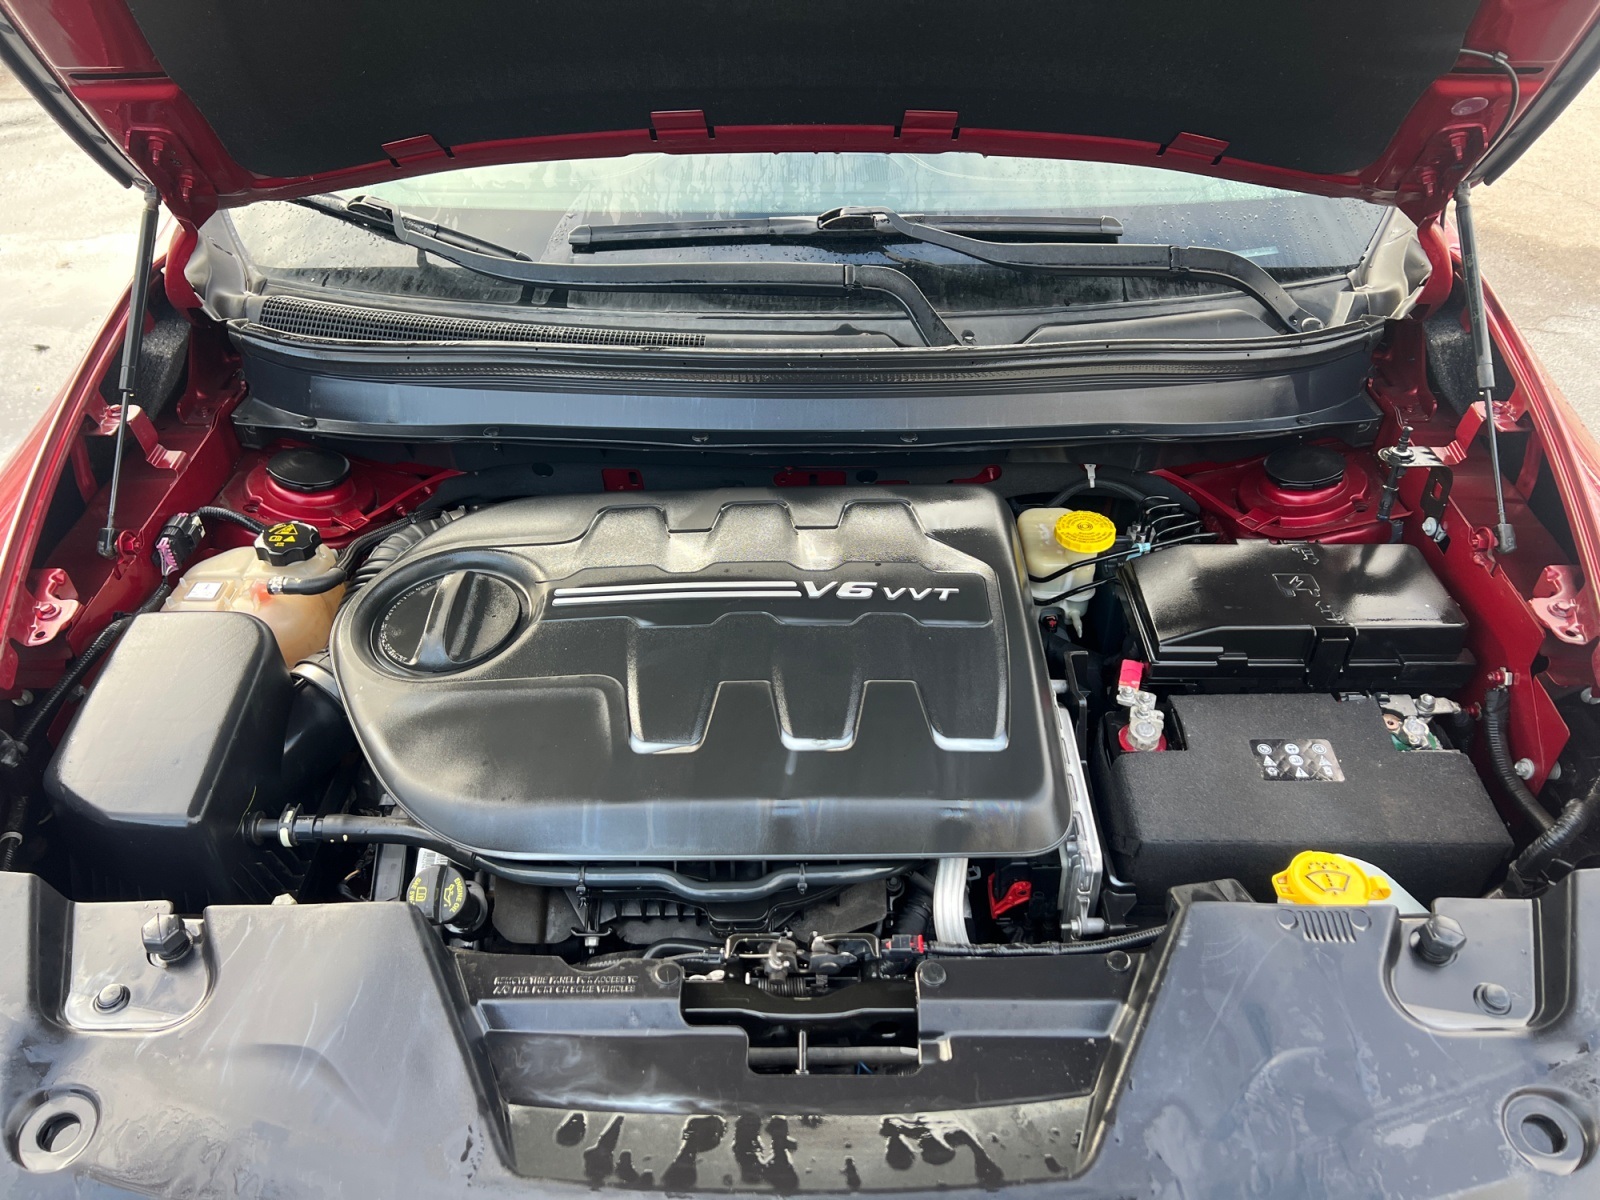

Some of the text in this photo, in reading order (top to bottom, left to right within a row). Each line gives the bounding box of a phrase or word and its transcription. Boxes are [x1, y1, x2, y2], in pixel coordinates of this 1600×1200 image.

[803, 581, 960, 601] V6 VVT
[449, 877, 464, 913] ENGINE OIL
